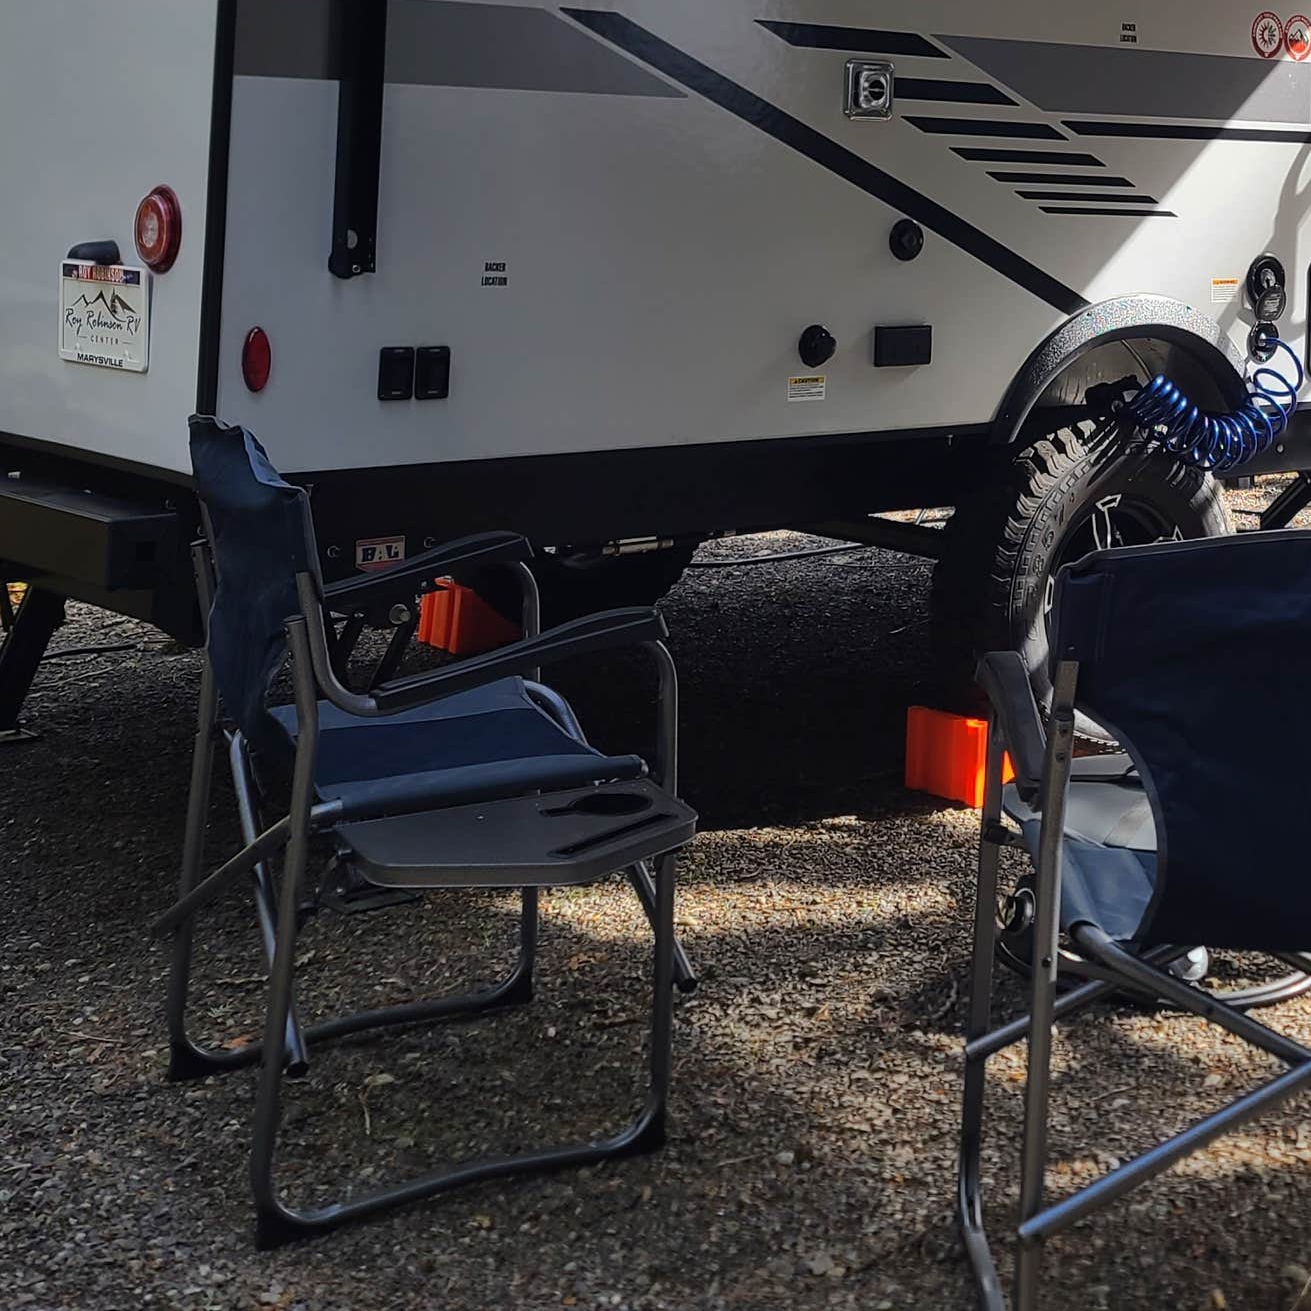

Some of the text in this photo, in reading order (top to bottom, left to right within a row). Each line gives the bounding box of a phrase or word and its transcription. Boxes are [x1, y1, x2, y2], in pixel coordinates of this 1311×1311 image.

[65, 308, 141, 336] Roy Robinson RV
[90, 335, 119, 345] CENTER
[77, 352, 124, 368] MARYSVILLE
